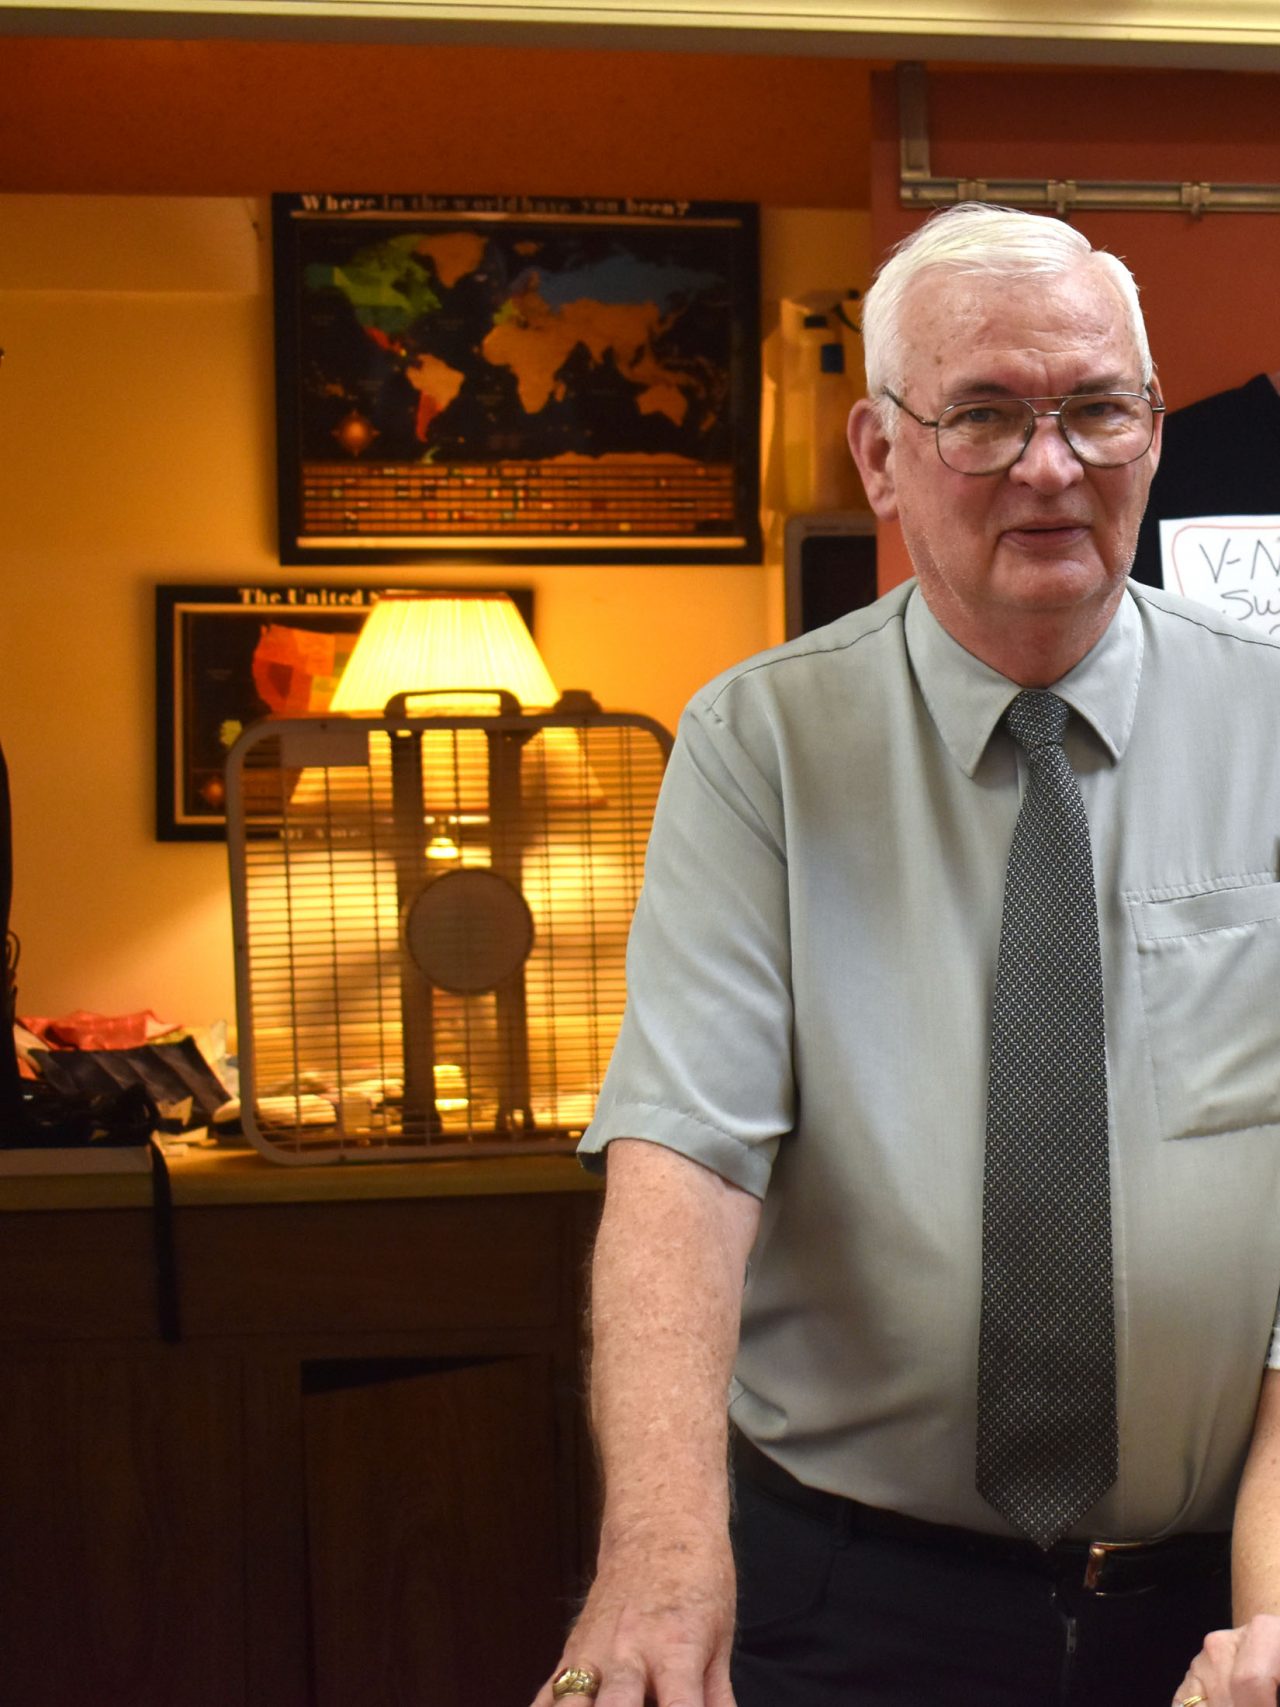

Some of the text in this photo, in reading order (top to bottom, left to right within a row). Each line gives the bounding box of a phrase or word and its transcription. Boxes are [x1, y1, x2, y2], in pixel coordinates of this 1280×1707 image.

[301, 193, 377, 211] Where
[239, 588, 282, 605] The
[287, 588, 364, 605] United
